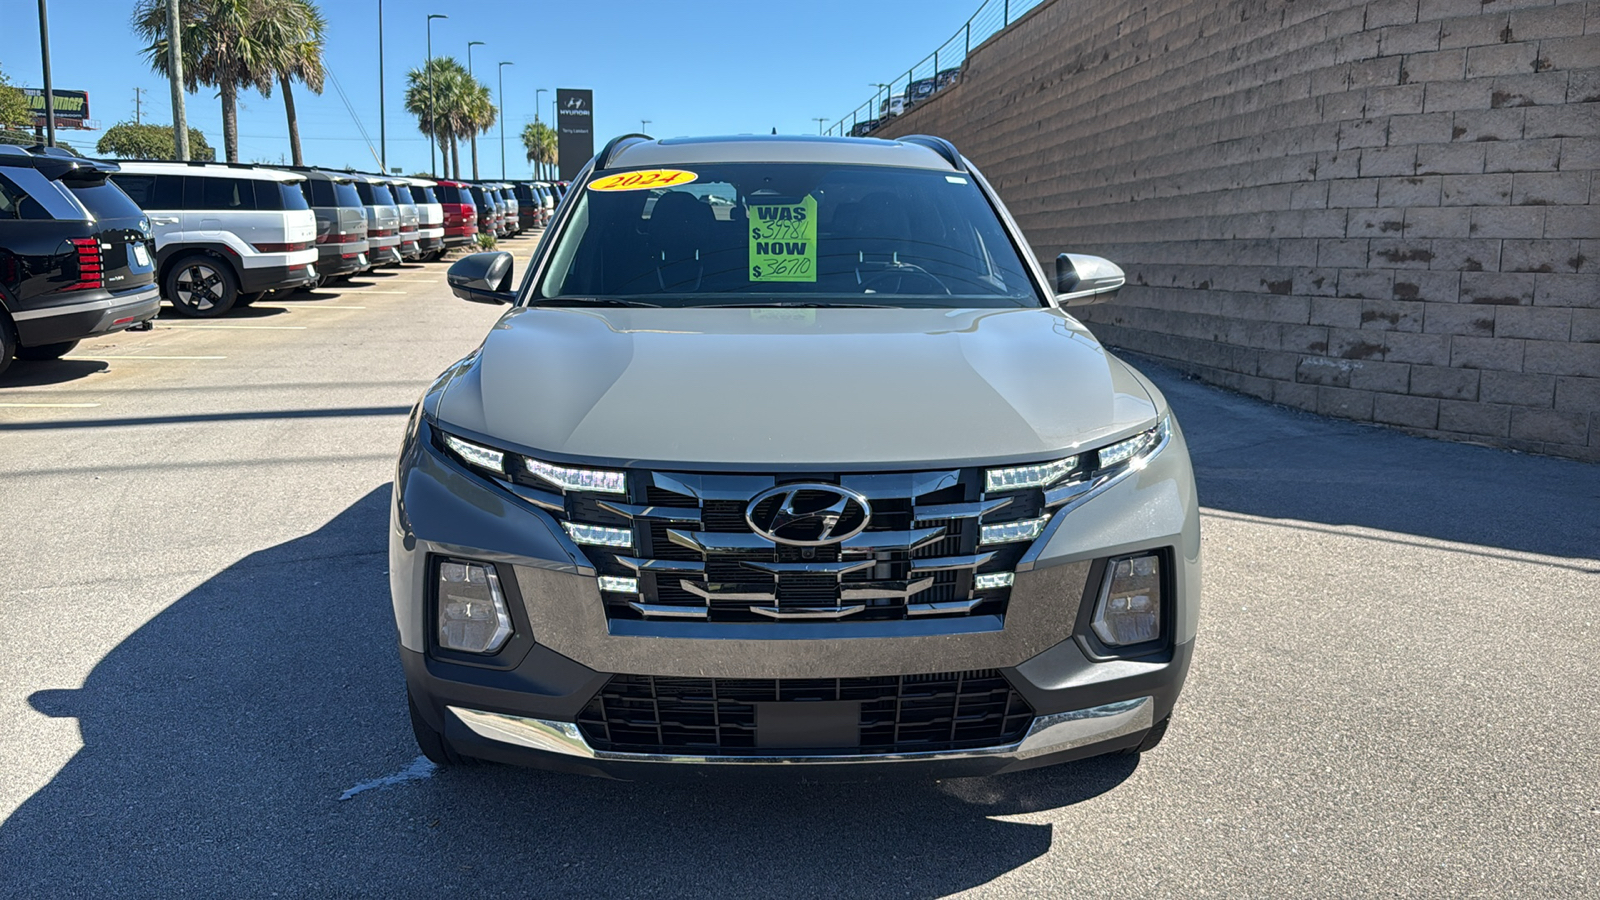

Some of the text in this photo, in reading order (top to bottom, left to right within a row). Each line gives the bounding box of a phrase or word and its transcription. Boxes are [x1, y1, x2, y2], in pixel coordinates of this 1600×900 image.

[602, 172, 682, 189] 2024
[757, 207, 806, 220] WAS
[756, 242, 807, 255] NOW
